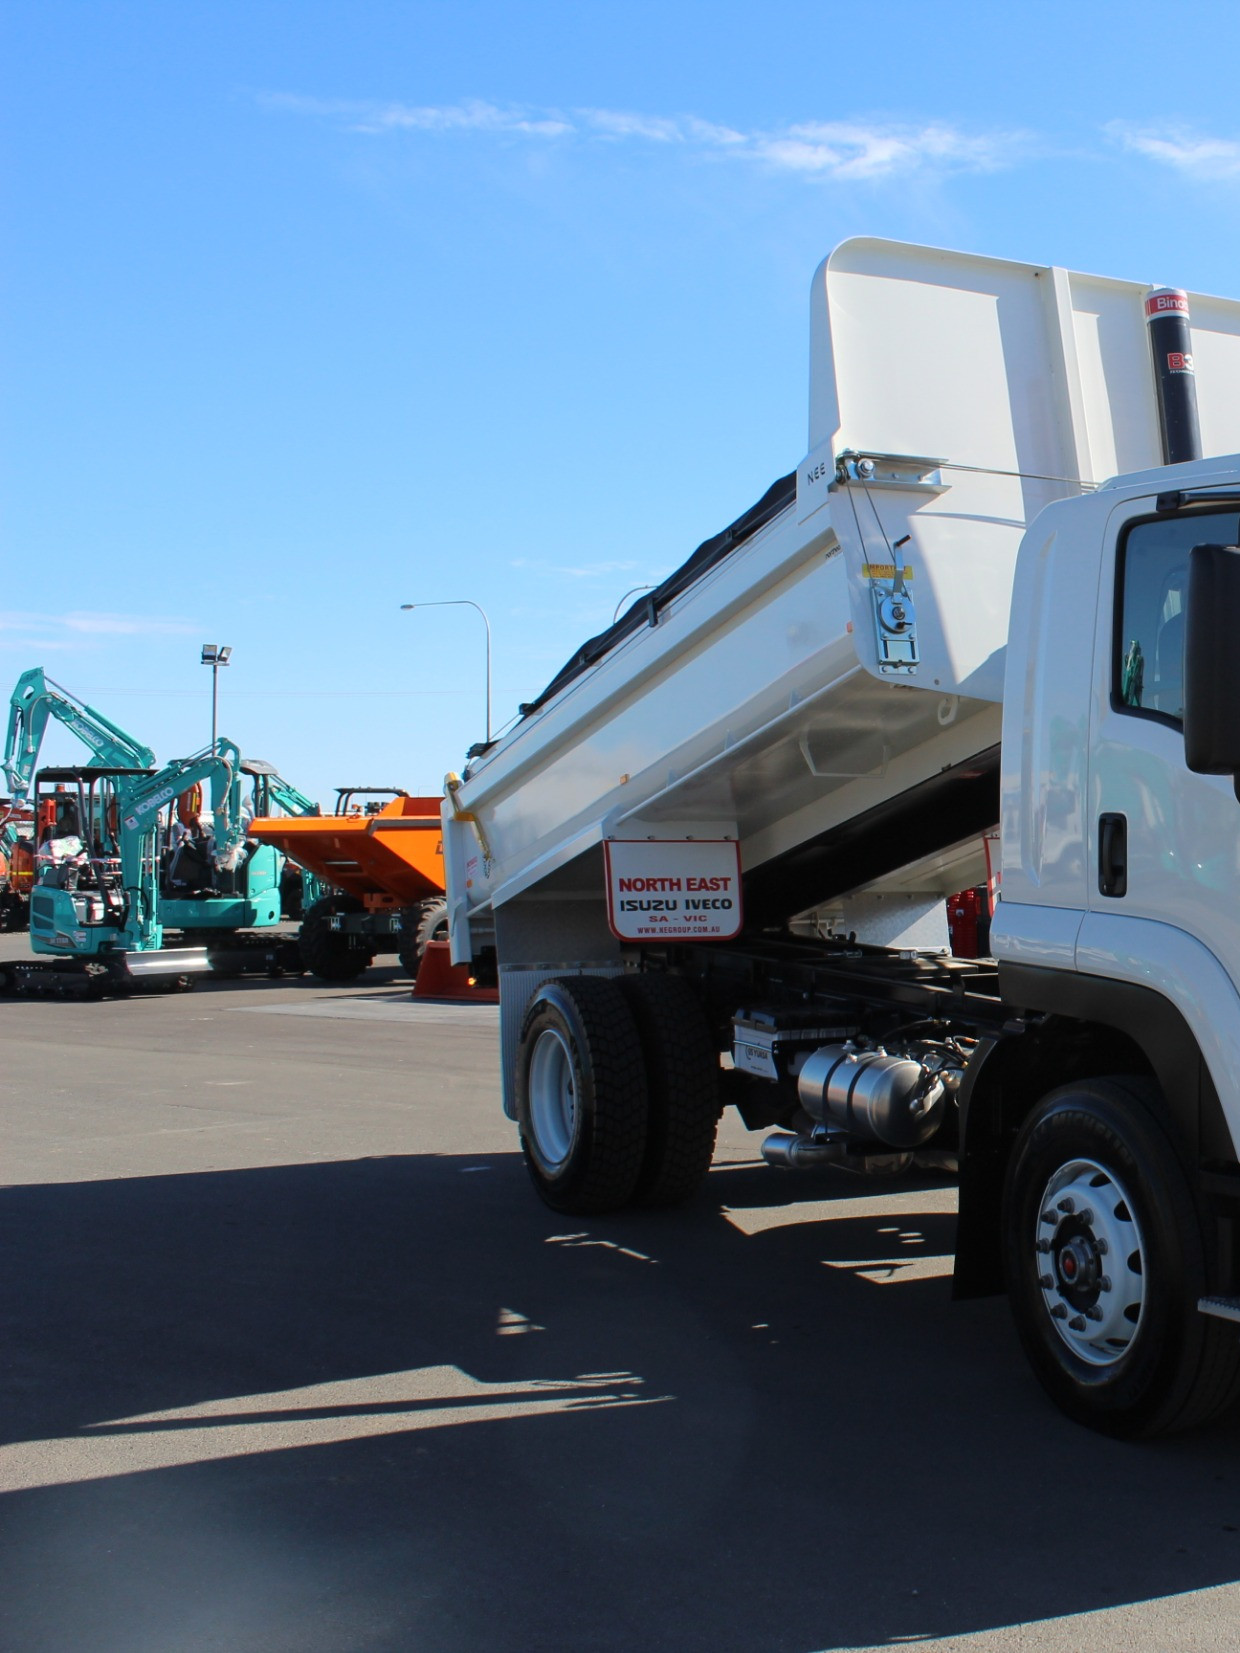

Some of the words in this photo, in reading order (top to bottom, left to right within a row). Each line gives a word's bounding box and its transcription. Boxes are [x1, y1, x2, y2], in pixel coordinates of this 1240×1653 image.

[1157, 297, 1189, 310] Bino
[807, 462, 826, 486] NEE
[71, 721, 104, 747] KOBELCO
[135, 787, 174, 815] KOBELCO
[619, 877, 681, 892] NORTH
[686, 877, 731, 891] EAST
[620, 900, 677, 911] ISUZU
[685, 898, 732, 910] IVECO
[637, 926, 720, 934] WWW.NEGROUP.COM.AU
